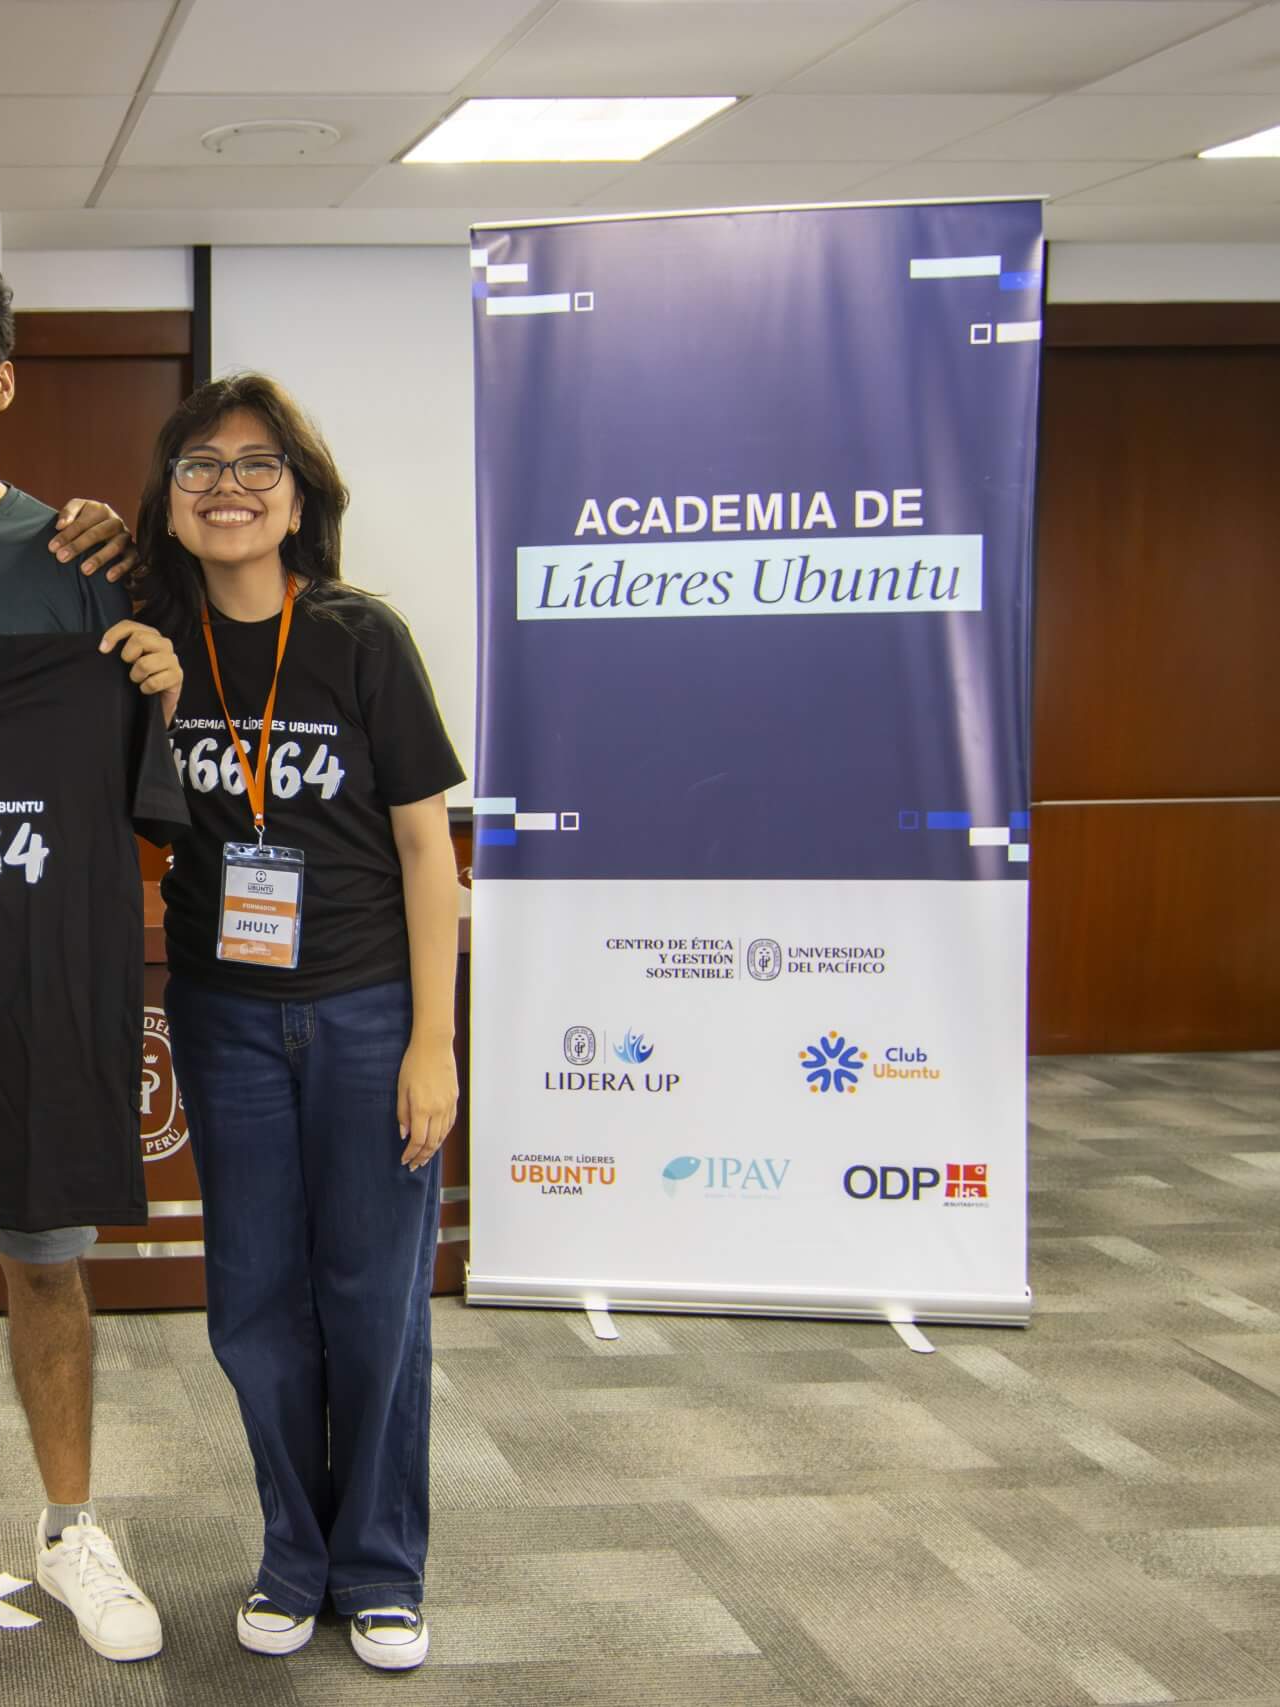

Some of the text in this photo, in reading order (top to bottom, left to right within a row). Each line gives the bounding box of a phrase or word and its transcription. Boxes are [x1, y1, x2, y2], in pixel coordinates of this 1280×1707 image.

[574, 488, 924, 536] ACADEMIA DE
[536, 554, 961, 610] Líderes Ubuntu
[176, 718, 226, 730] CADEMIA
[243, 716, 285, 731] LÍDEES
[289, 722, 338, 736] UBUNTU
[236, 919, 280, 935] JHULY
[606, 936, 734, 951] CENTRO DE ÉTICA
[658, 951, 734, 965] Y GESTIÓN
[787, 947, 885, 959] UNIVERSIDAD
[645, 968, 734, 980] SOSTENIBLE
[787, 960, 885, 974] DEL PACÍFICO
[885, 1047, 928, 1063] Club
[872, 1063, 941, 1079] Ubuntu
[545, 1071, 680, 1092] LIDERA UP
[145, 1127, 181, 1153] PERÚ
[510, 1154, 561, 1163] ACADEMIA
[576, 1153, 616, 1164] LÍDERES
[510, 1164, 616, 1185] UBUNTU
[703, 1156, 791, 1190] IPAV
[541, 1185, 583, 1196] LATAM
[843, 1164, 941, 1201] ODP
